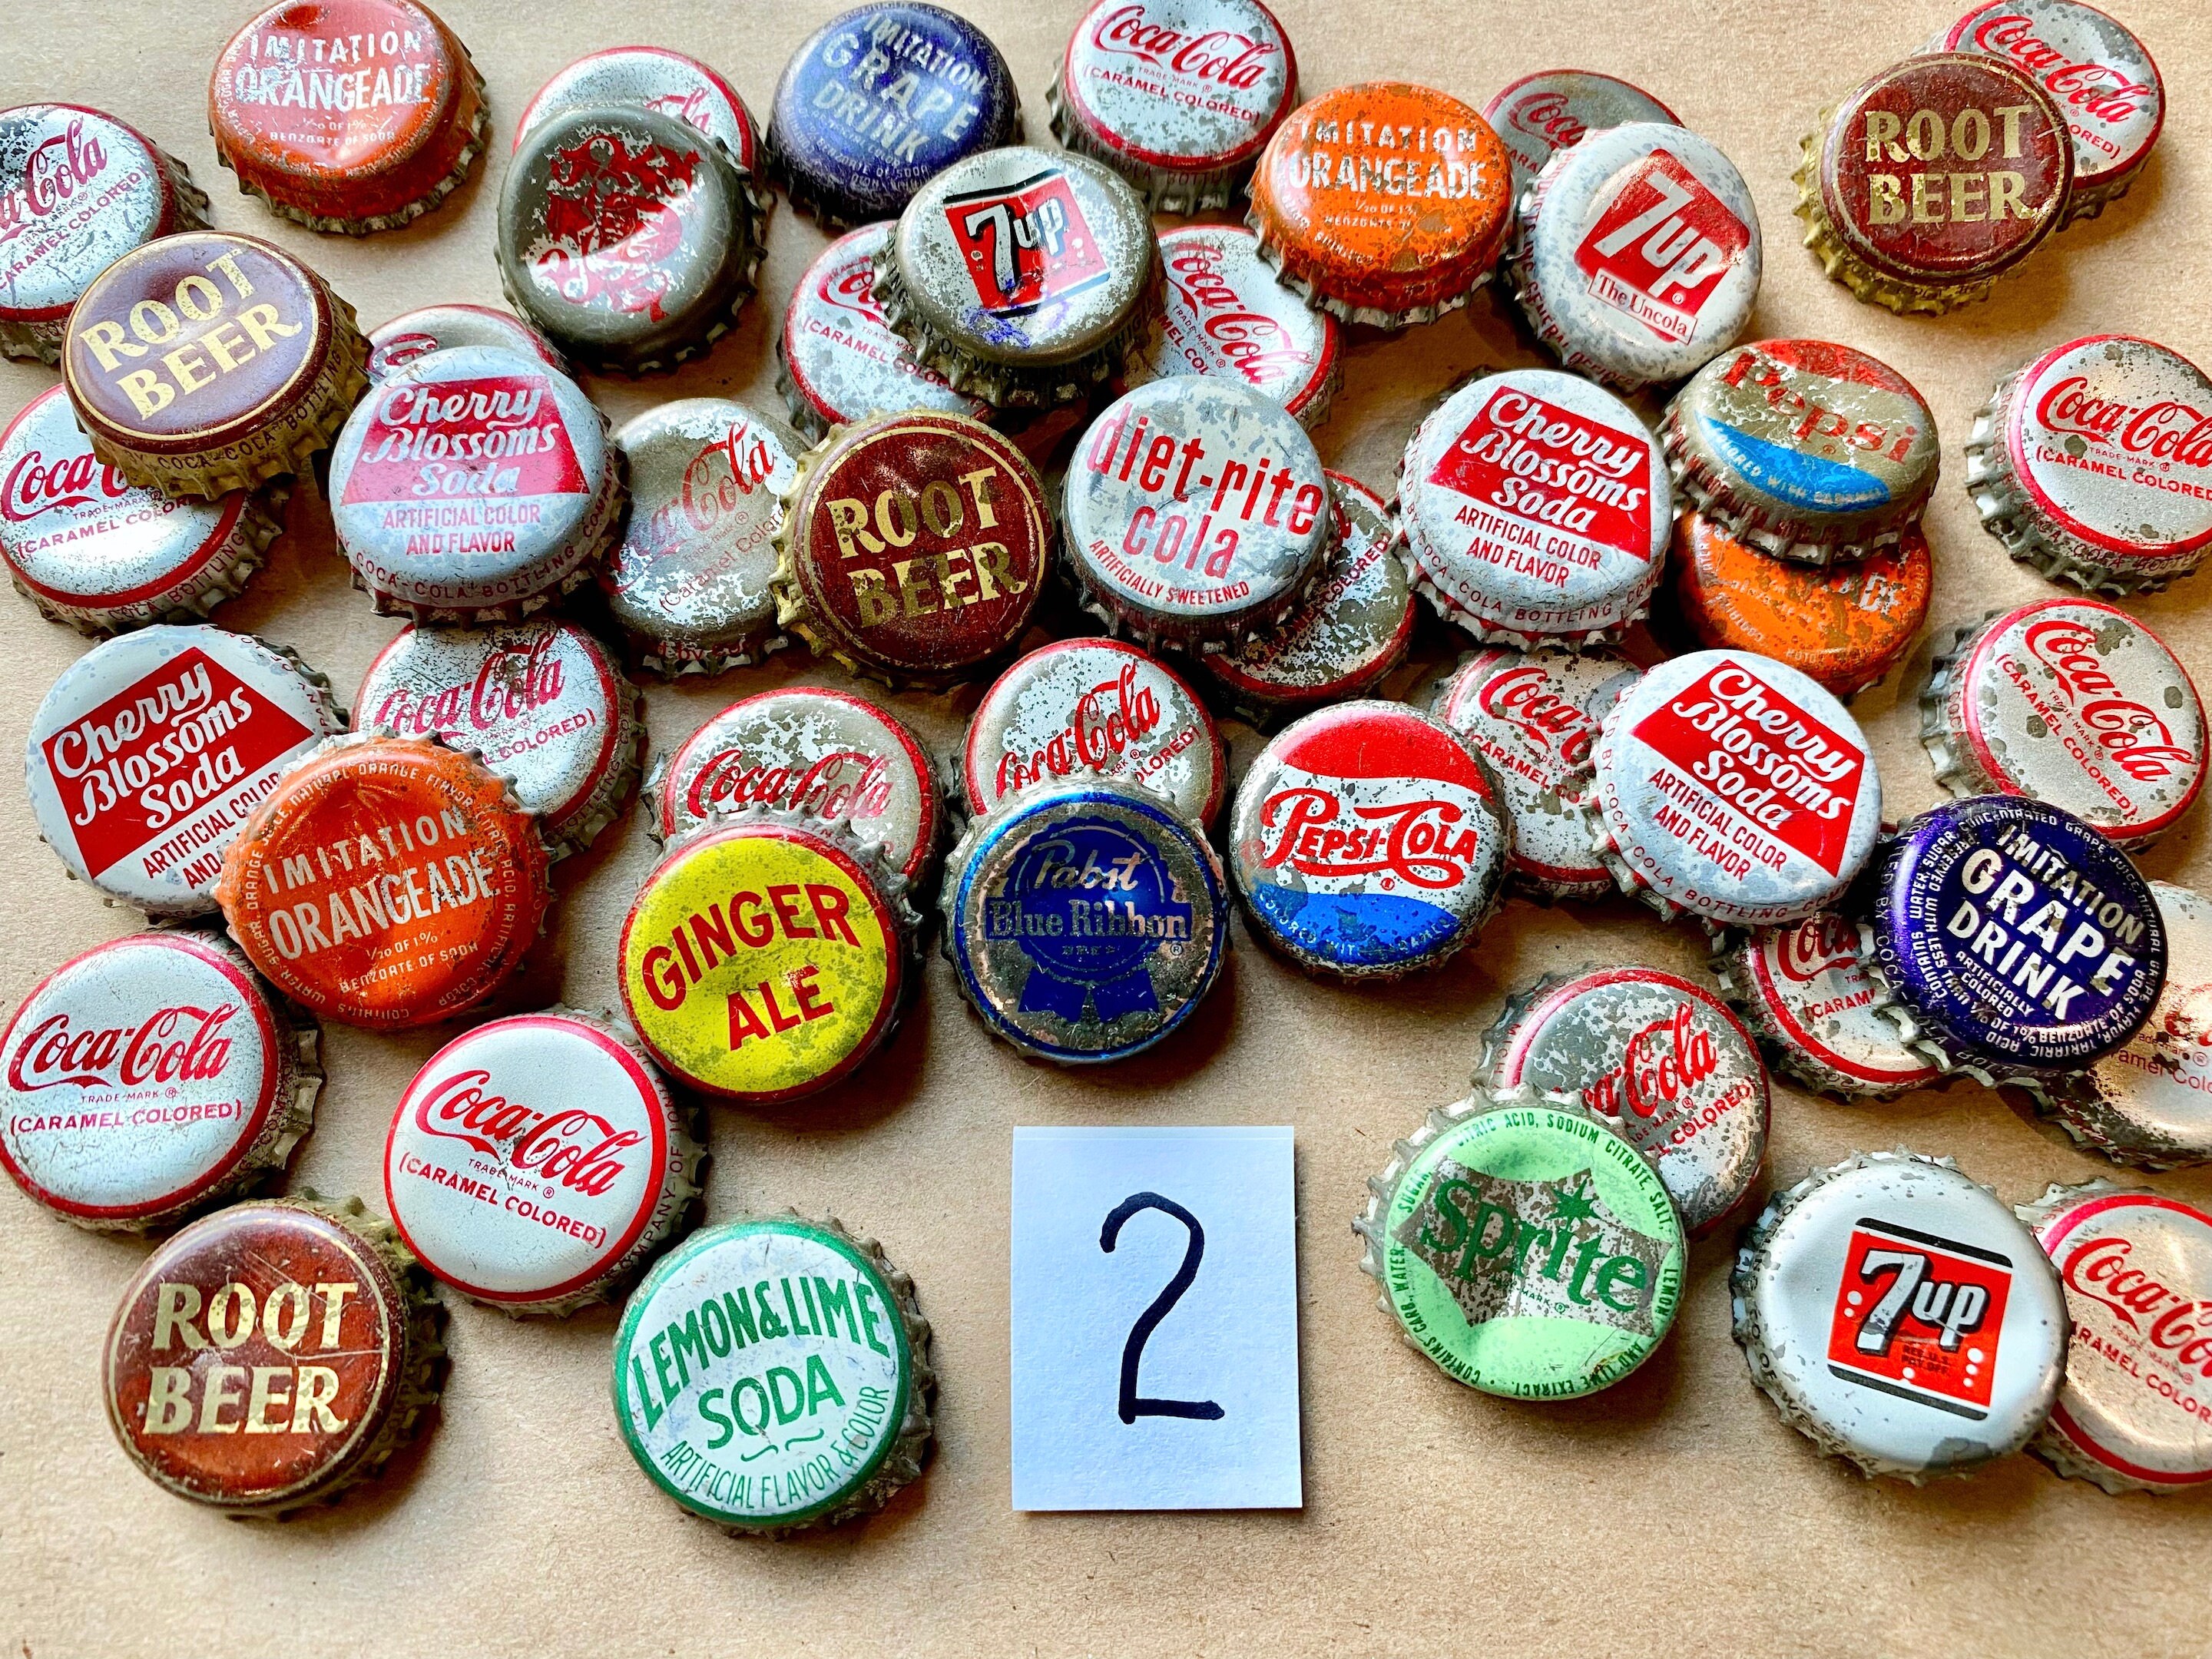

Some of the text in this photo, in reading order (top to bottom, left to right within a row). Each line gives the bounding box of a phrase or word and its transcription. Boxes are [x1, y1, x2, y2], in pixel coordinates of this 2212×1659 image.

[247, 29, 423, 65] IMITATION
[863, 13, 989, 96] IMITATION
[1091, 5, 1280, 91] Coca-Cola
[1974, 15, 2154, 123] Coca-Cola
[234, 62, 432, 112] ORANGEADE
[812, 79, 930, 164] DRINK
[822, 33, 980, 143] GRAPE
[1083, 63, 1261, 126] (CARAMEL COLORED)
[1300, 120, 1477, 153] IMITATION
[1863, 104, 2035, 163] ROOT
[1289, 150, 1487, 200] ORANGEADE
[1866, 168, 2041, 227] BEER
[79, 247, 258, 373] ROOT
[803, 317, 888, 365] (CARAMEL
[1167, 243, 1315, 384] Coca-Cola
[1598, 273, 1688, 338] The Uncola
[114, 303, 303, 421] BEER
[363, 421, 561, 463] Blossoms
[379, 384, 543, 428] Cherry
[1487, 392, 1644, 478] Cherry
[1719, 351, 1919, 466] Pepsi
[412, 462, 520, 495] Soda
[1086, 402, 1325, 535] diet-rite
[1460, 429, 1648, 513] Blossoms
[2035, 444, 2128, 481] (CARAMEL
[17, 519, 120, 560] (CARAMEL
[382, 505, 540, 529] ARTIFICIAL COLOR
[1122, 505, 1240, 579] cola
[1454, 505, 1604, 571] ARTIFICIAL COLOR
[1490, 478, 1598, 534] Soda
[167, 531, 246, 604] BOTTLING
[356, 551, 464, 598] COCA-COLA
[482, 545, 576, 598] BOTTLING
[406, 531, 516, 555] AND FLAVOR
[1089, 540, 1251, 605] ARTIFICIALLY SWEETENED
[1465, 537, 1570, 588] AND FLAVOR
[1514, 601, 1614, 625] BOTTLING
[52, 661, 214, 779] Cherry
[374, 628, 566, 743] Coca-Cola
[2025, 620, 2197, 782] Coca-Cola
[74, 686, 253, 826] Blossoms
[498, 706, 598, 757] COLORED)
[1671, 697, 1854, 820] Blossoms
[1708, 668, 1858, 782] Cherry
[1995, 653, 2141, 819] (CARAMEL COLORED)
[139, 744, 247, 830] Soda
[357, 762, 419, 780] ORANGE
[687, 748, 895, 820] Coca-Cola
[1692, 750, 1793, 831] Soda
[141, 806, 236, 879] ARTIFICIAL
[262, 806, 469, 895] IMITATION
[1606, 783, 1674, 889] COCA-COLA
[1684, 889, 1790, 919] BOTTLING
[1648, 768, 1788, 872] ARTIFICIAL COLOR
[1654, 804, 1752, 882] AND FLAVOR
[2065, 821, 2105, 854] GRAPE
[1030, 838, 1144, 891] Pabst
[1995, 824, 2149, 948] IMITATION
[268, 847, 502, 962] ORANGEADE
[988, 898, 1188, 939] Blue Ribbon
[1923, 896, 1939, 932] WITH
[1962, 847, 2136, 998] GRAPE
[393, 937, 410, 953] OF
[418, 953, 436, 969] OF
[641, 882, 862, 1012] GINGER
[1927, 936, 1949, 969] LESS
[1945, 899, 2088, 1022] DRINK
[727, 964, 836, 1052] ALE
[1955, 950, 2036, 1018] ARTIFICIALLY
[1960, 972, 2015, 1018] COLORED
[8, 1002, 240, 1091] Coca-Cola
[10, 1098, 243, 1137] (CARAMEL COLORED)
[80, 1090, 160, 1104] TRADE-MARK
[416, 1069, 647, 1198] Coca-Cola
[1671, 1076, 1758, 1146] COLORED)
[1545, 1112, 1600, 1144] SODIUM
[1604, 1140, 1647, 1191] CITRATE,
[398, 1151, 608, 1248] (CARAMEL COLORED)
[1419, 1177, 1648, 1313] Sprite
[151, 1281, 360, 1351] ROOT
[1098, 1190, 1226, 1426] 2
[1854, 1247, 1992, 1357] 7up
[142, 1366, 349, 1435] BEER
[697, 1353, 846, 1450] SODA
[661, 1440, 756, 1509] ARTIFICIAL
[760, 1454, 841, 1508] FLAVOR
[842, 1386, 890, 1451] COLOR
